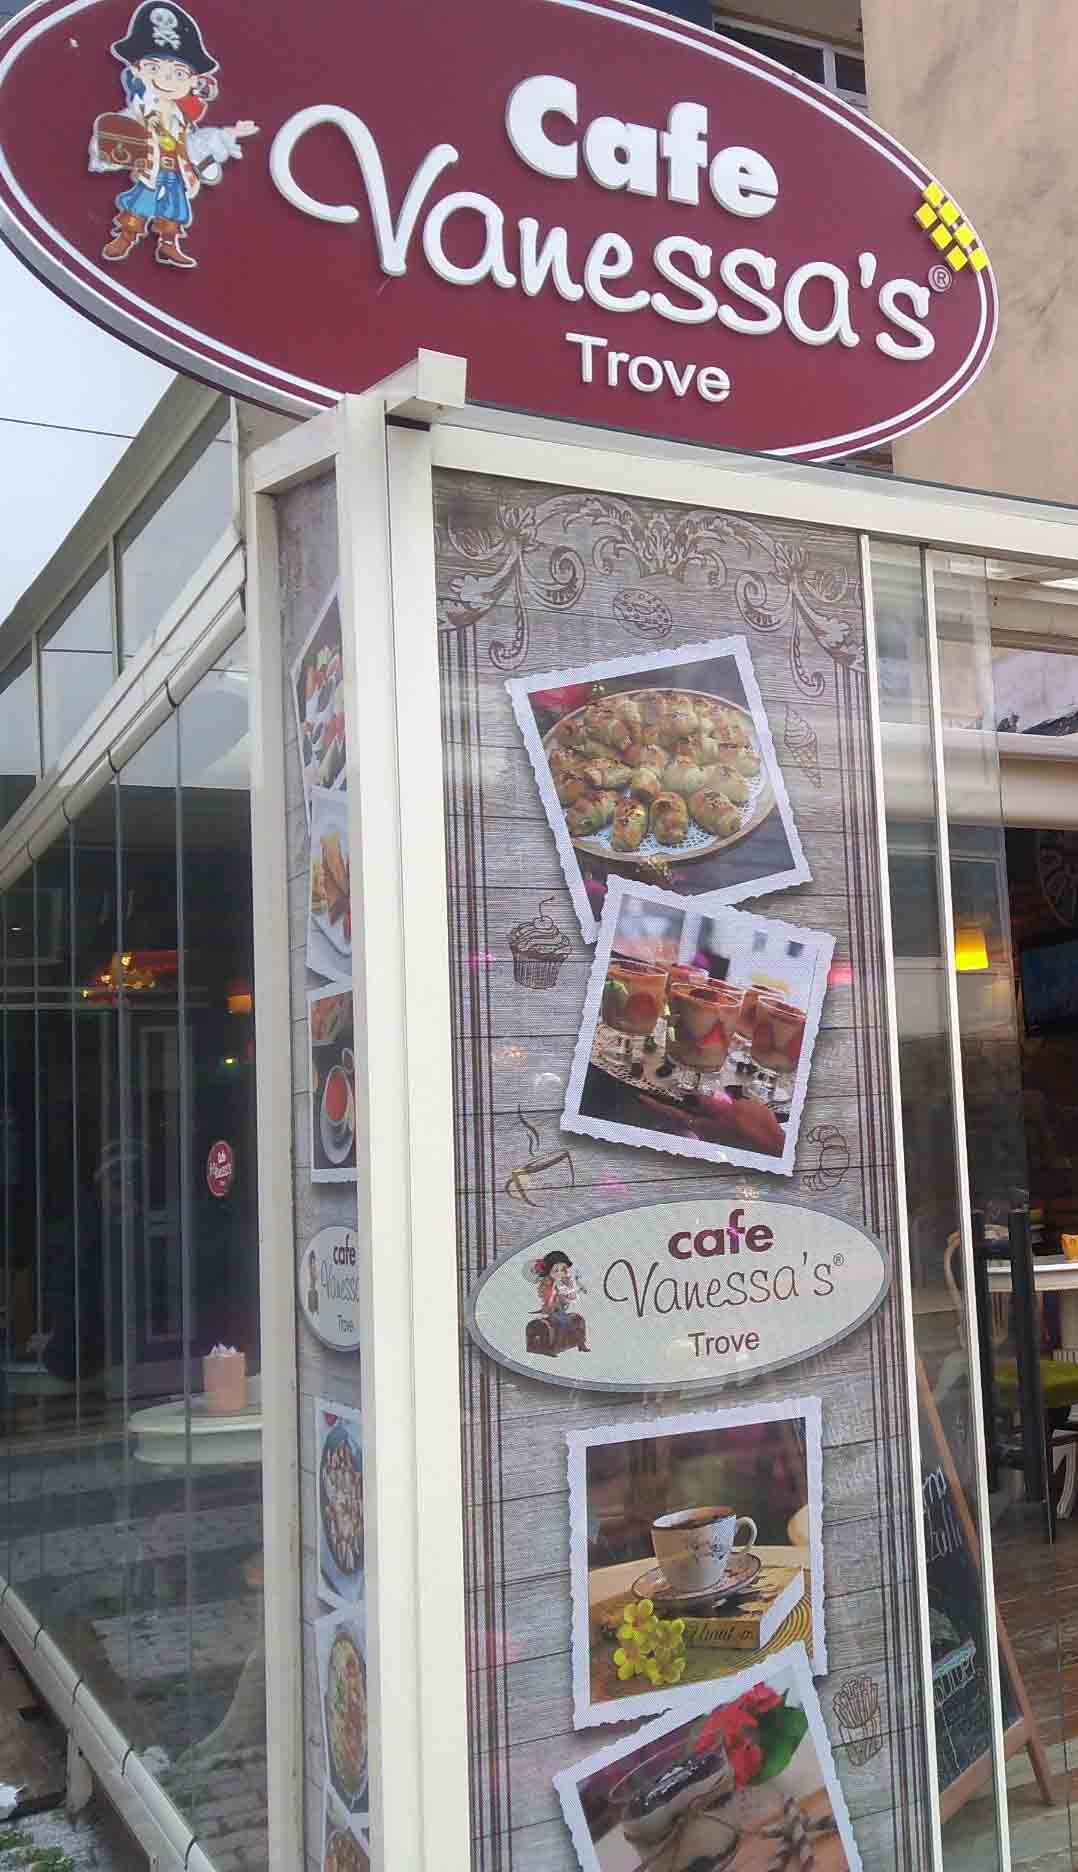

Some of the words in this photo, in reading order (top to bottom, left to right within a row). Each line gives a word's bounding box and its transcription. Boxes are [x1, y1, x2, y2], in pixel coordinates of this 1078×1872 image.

[504, 74, 779, 218] Cafe
[268, 103, 937, 363] Vanessa's
[565, 332, 731, 403] Trove
[668, 1209, 774, 1260] cafe
[603, 1252, 834, 1318] Vanessa's
[687, 1329, 761, 1357] Trove
